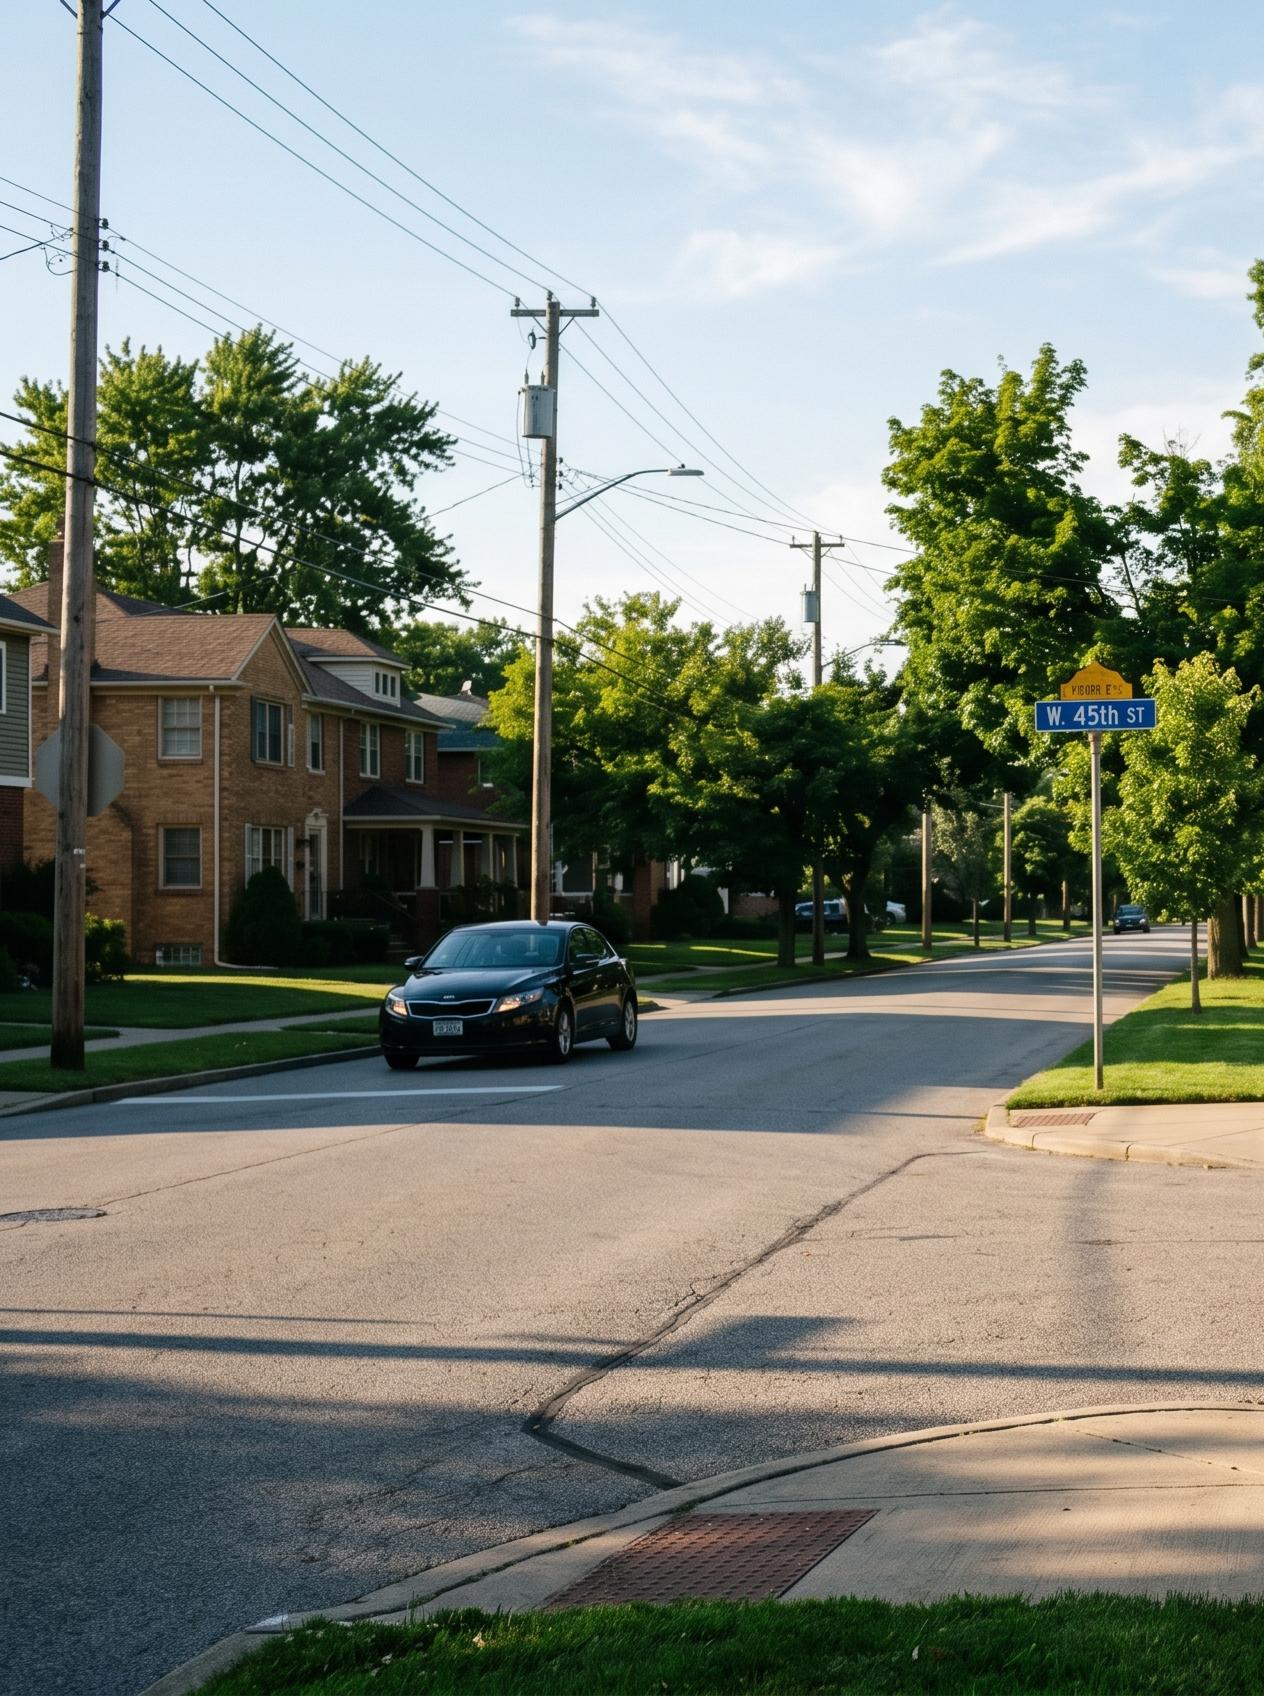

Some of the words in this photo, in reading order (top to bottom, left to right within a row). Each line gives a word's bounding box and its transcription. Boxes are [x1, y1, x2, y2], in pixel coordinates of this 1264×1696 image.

[1046, 706, 1065, 726] W.
[1073, 705, 1119, 726] 45th
[1127, 707, 1145, 723] ST
